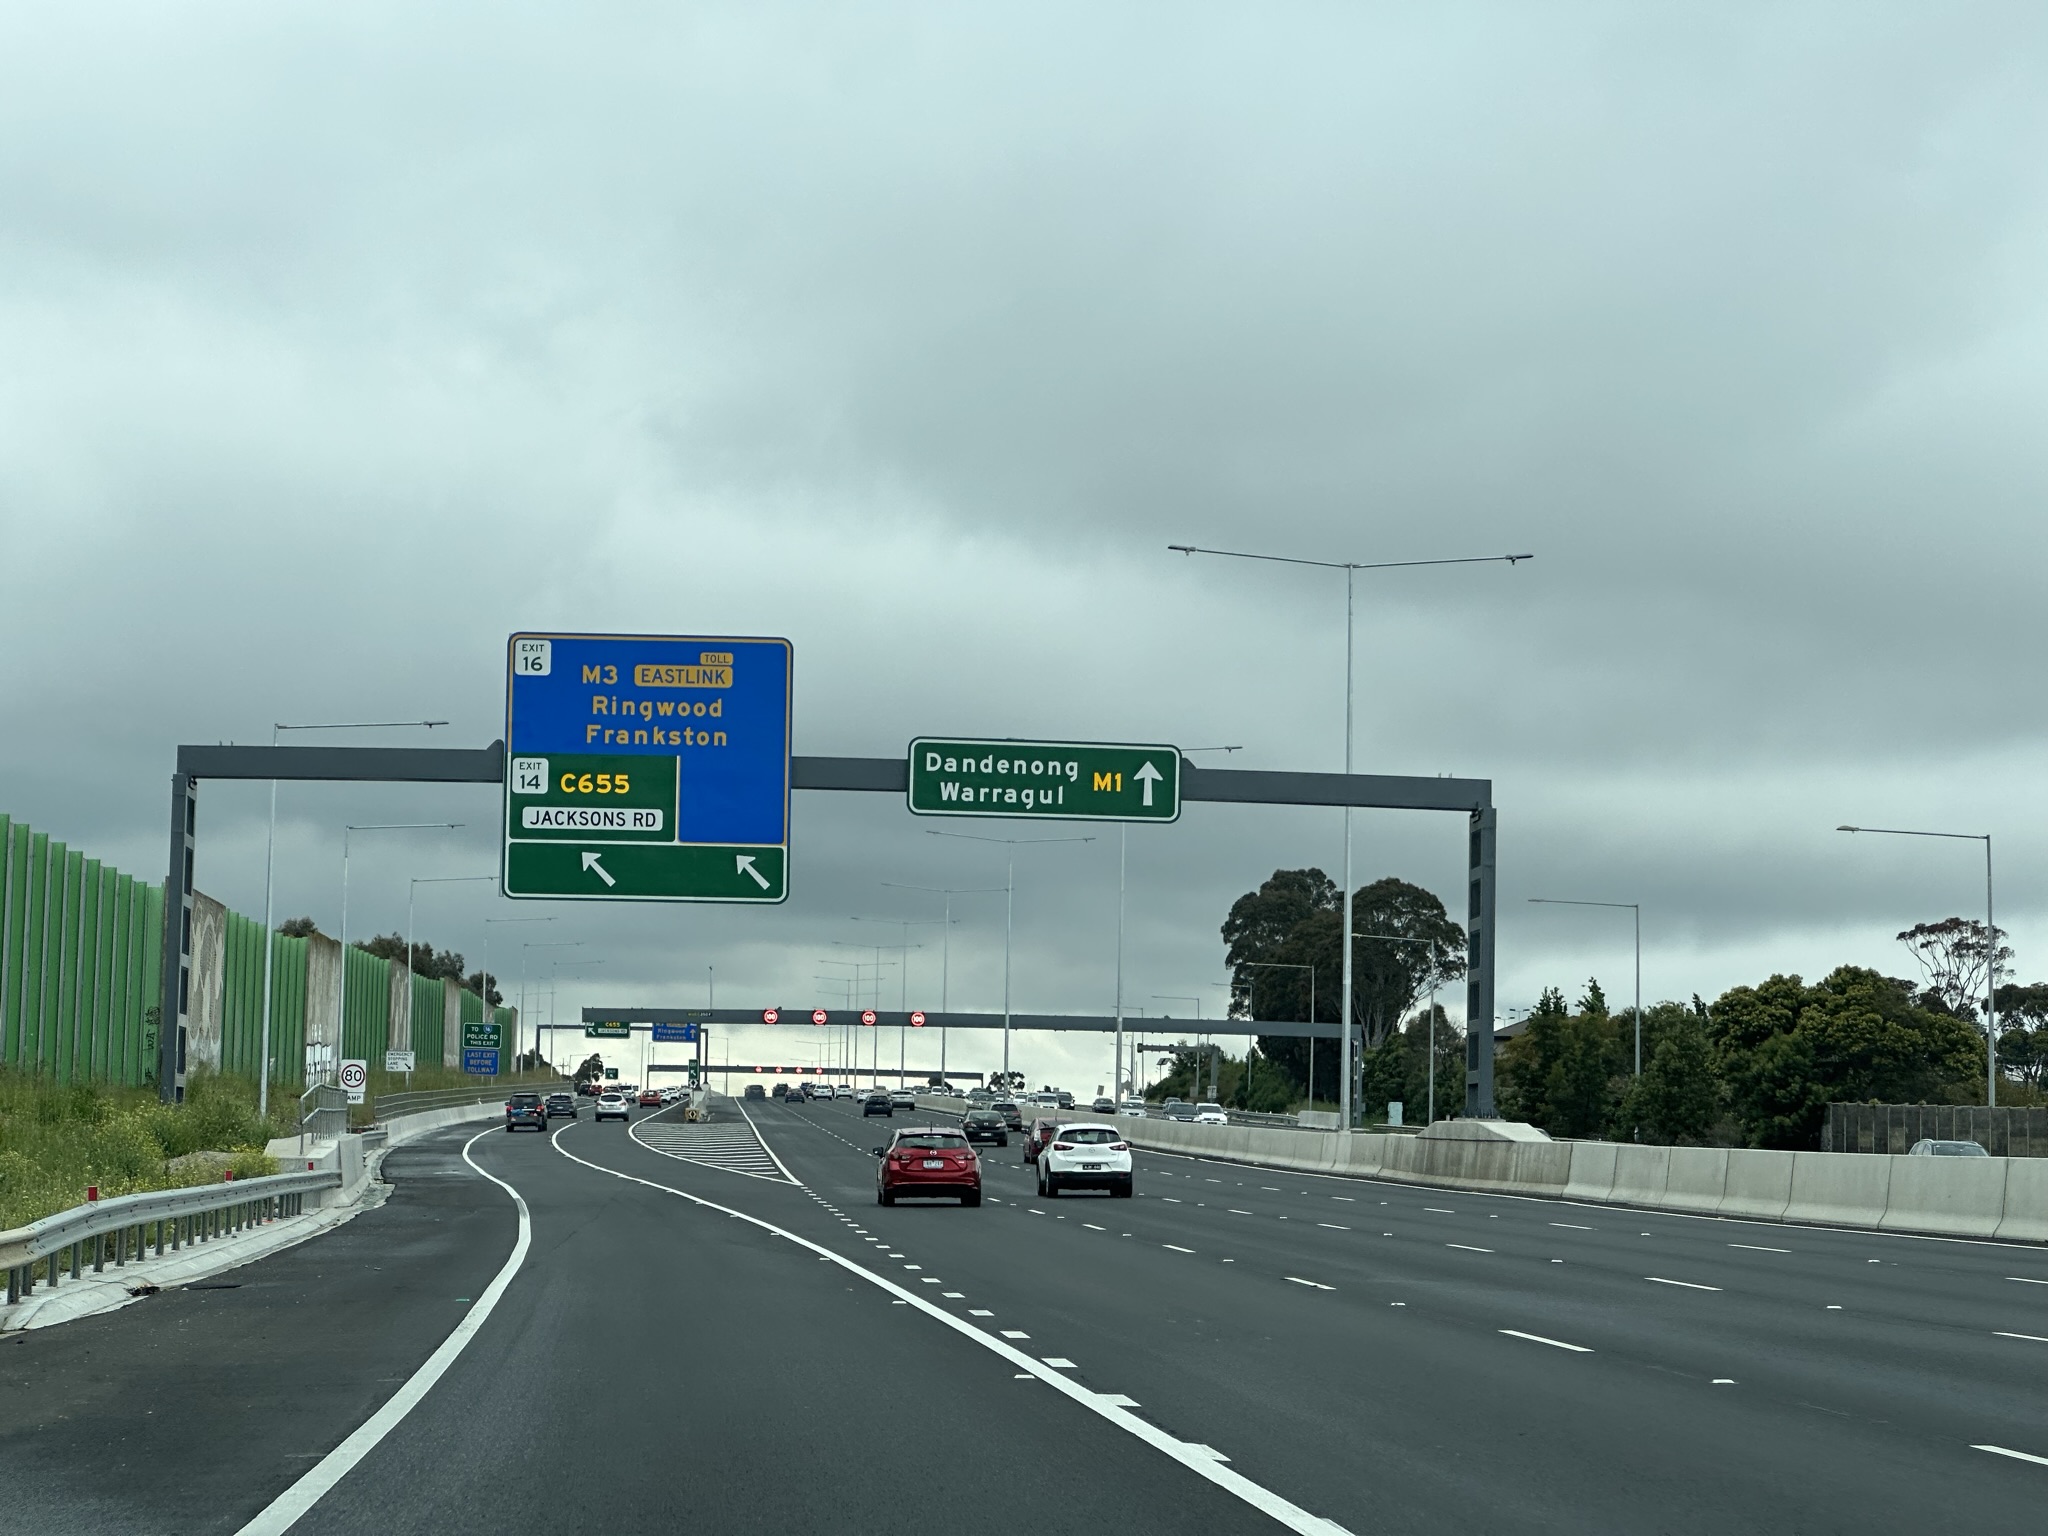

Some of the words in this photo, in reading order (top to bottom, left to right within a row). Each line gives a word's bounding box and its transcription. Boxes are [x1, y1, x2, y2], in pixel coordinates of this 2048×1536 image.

[522, 644, 544, 652] EXIT
[523, 656, 543, 671] 16
[705, 655, 729, 664] TOLL
[582, 665, 618, 684] M3
[641, 668, 726, 684] EASTLINK
[592, 695, 723, 721] Ringwood
[586, 725, 727, 746] Frankston
[519, 762, 542, 771] EXIT
[925, 752, 1079, 782] Dandenong
[520, 774, 541, 789] 14
[560, 773, 630, 794] C655
[1093, 772, 1122, 792] M1
[940, 782, 1063, 810] Warragul
[530, 810, 626, 827] JACKSONS
[633, 812, 656, 828] RD
[345, 1070, 362, 1081] 80
